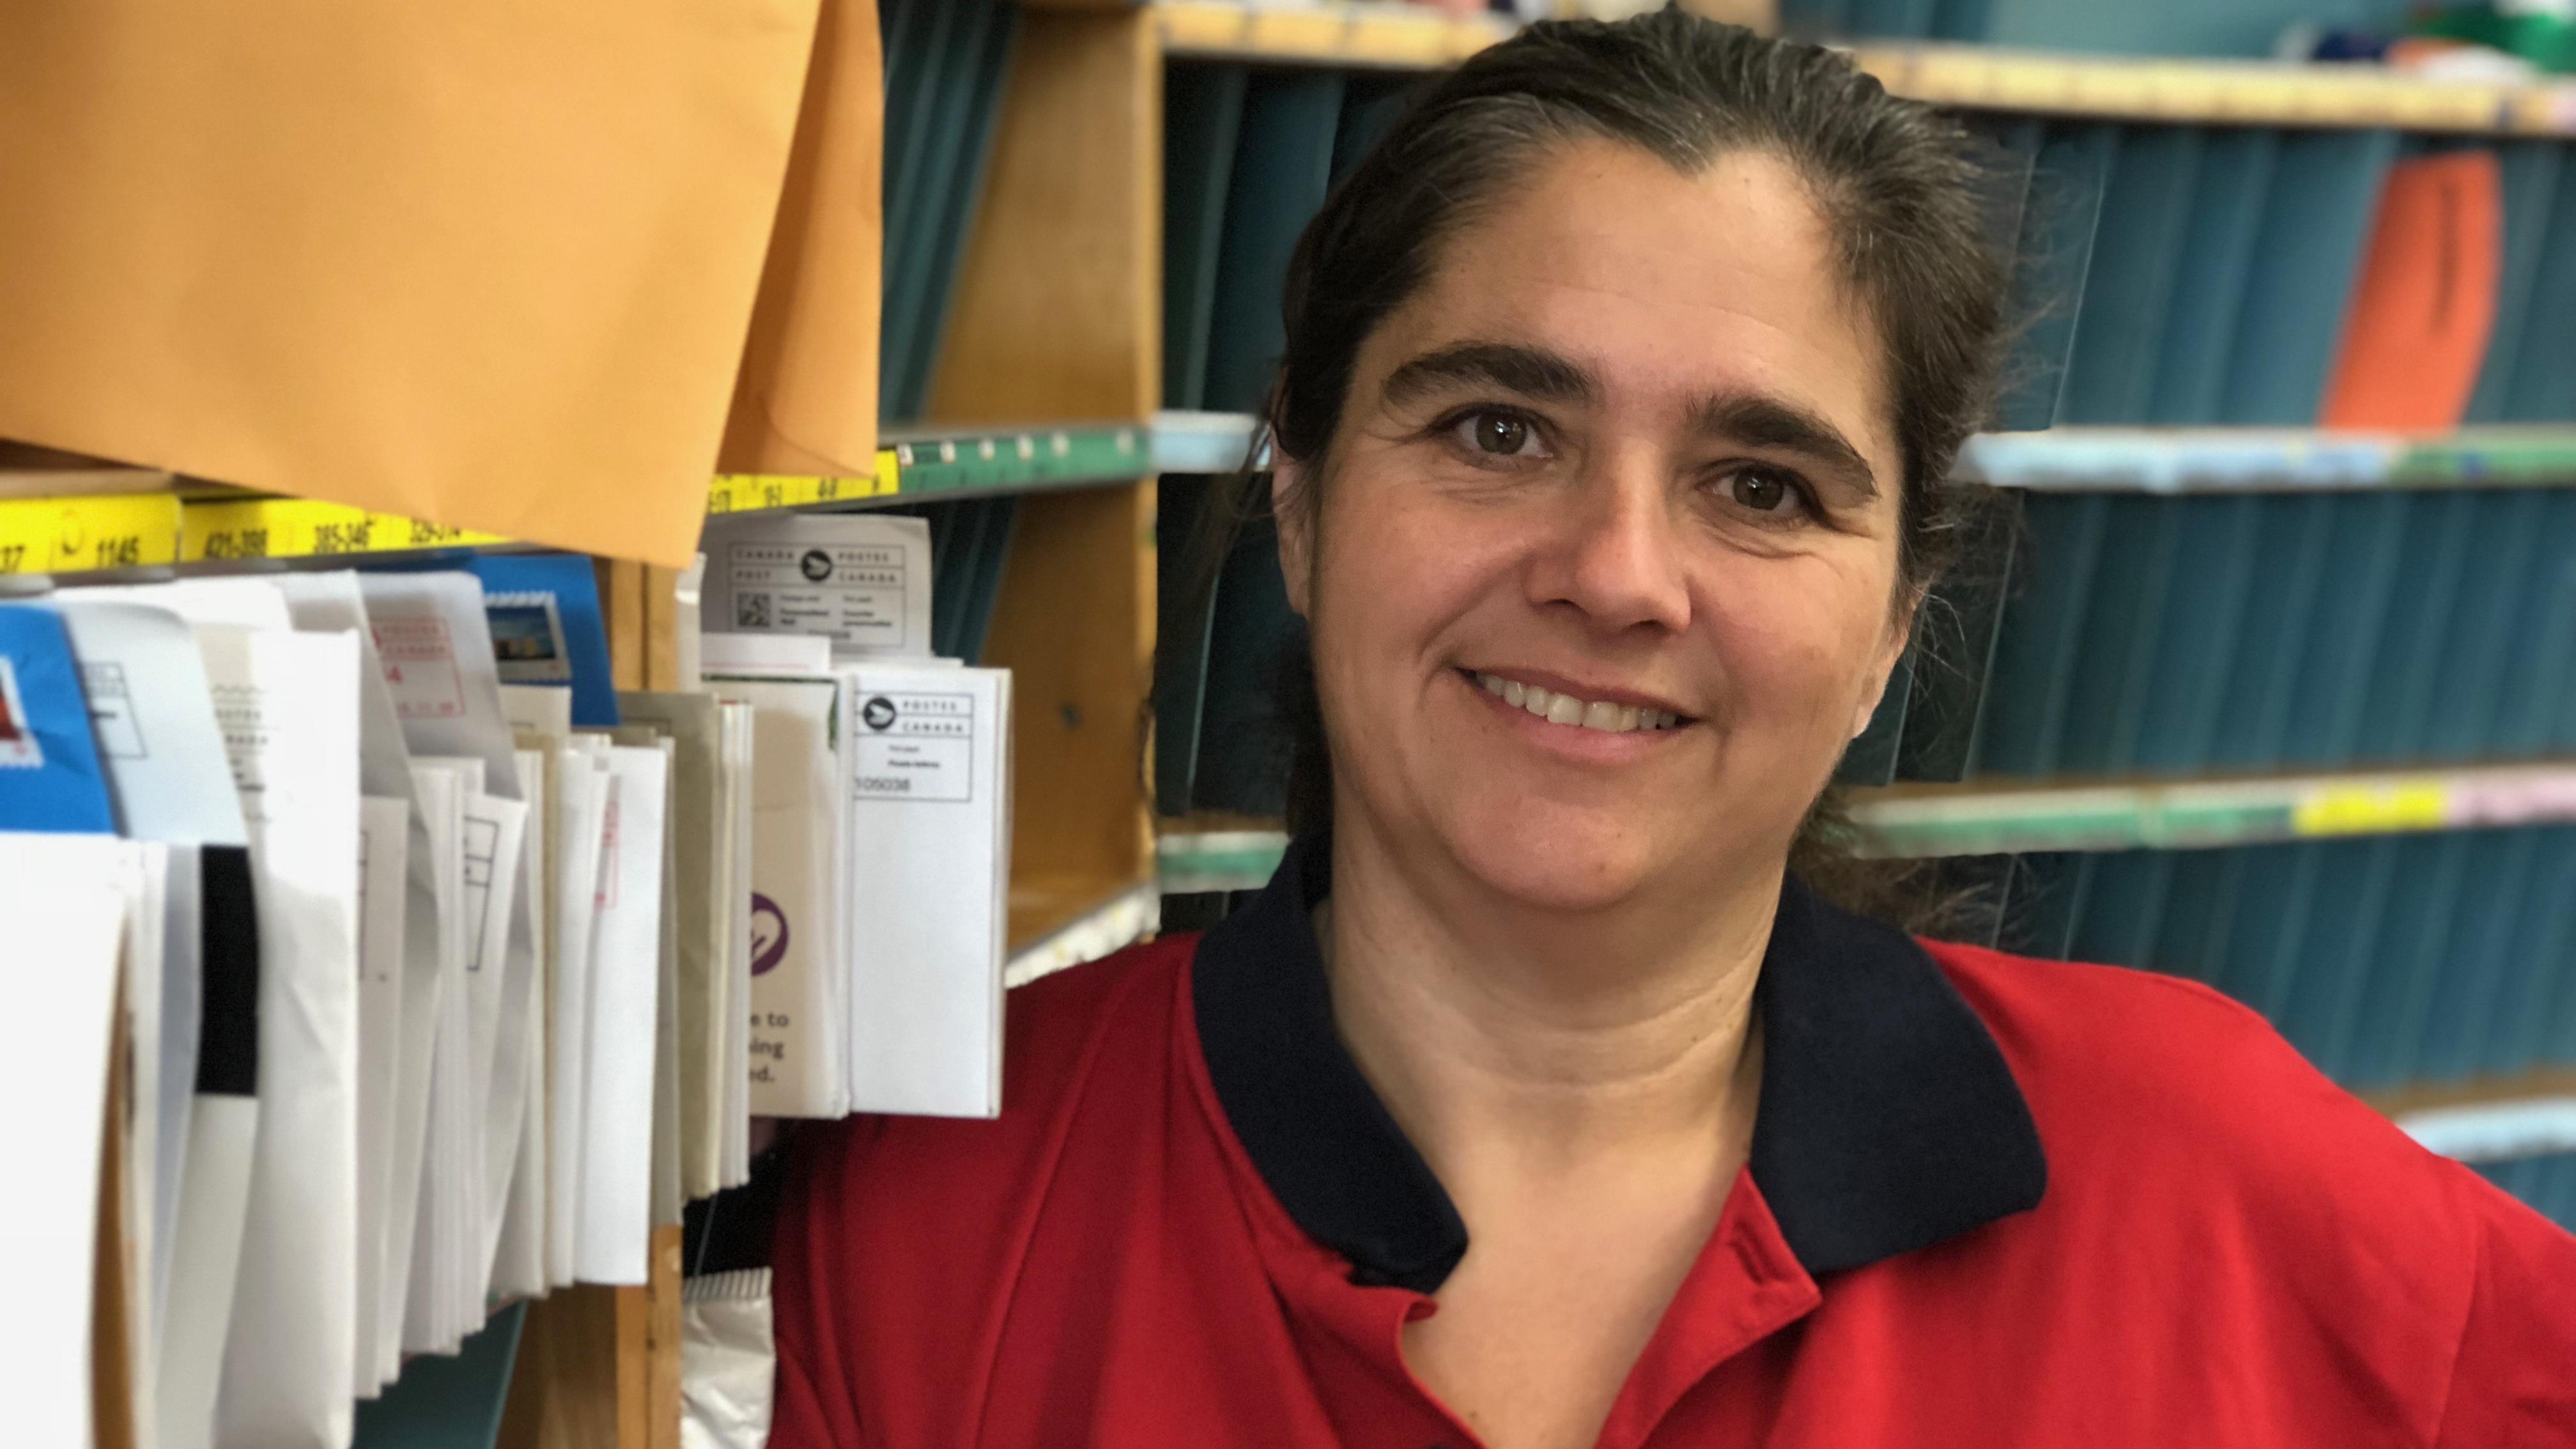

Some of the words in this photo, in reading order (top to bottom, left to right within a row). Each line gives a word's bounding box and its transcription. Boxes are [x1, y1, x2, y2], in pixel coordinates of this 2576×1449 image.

[735, 550, 794, 560] CANADA
[837, 550, 890, 562] POSTES
[735, 570, 771, 580] POST
[838, 573, 896, 583] CANADA
[902, 699, 957, 711] POSTES
[902, 720, 964, 732] CANADA
[767, 1012, 789, 1027] to
